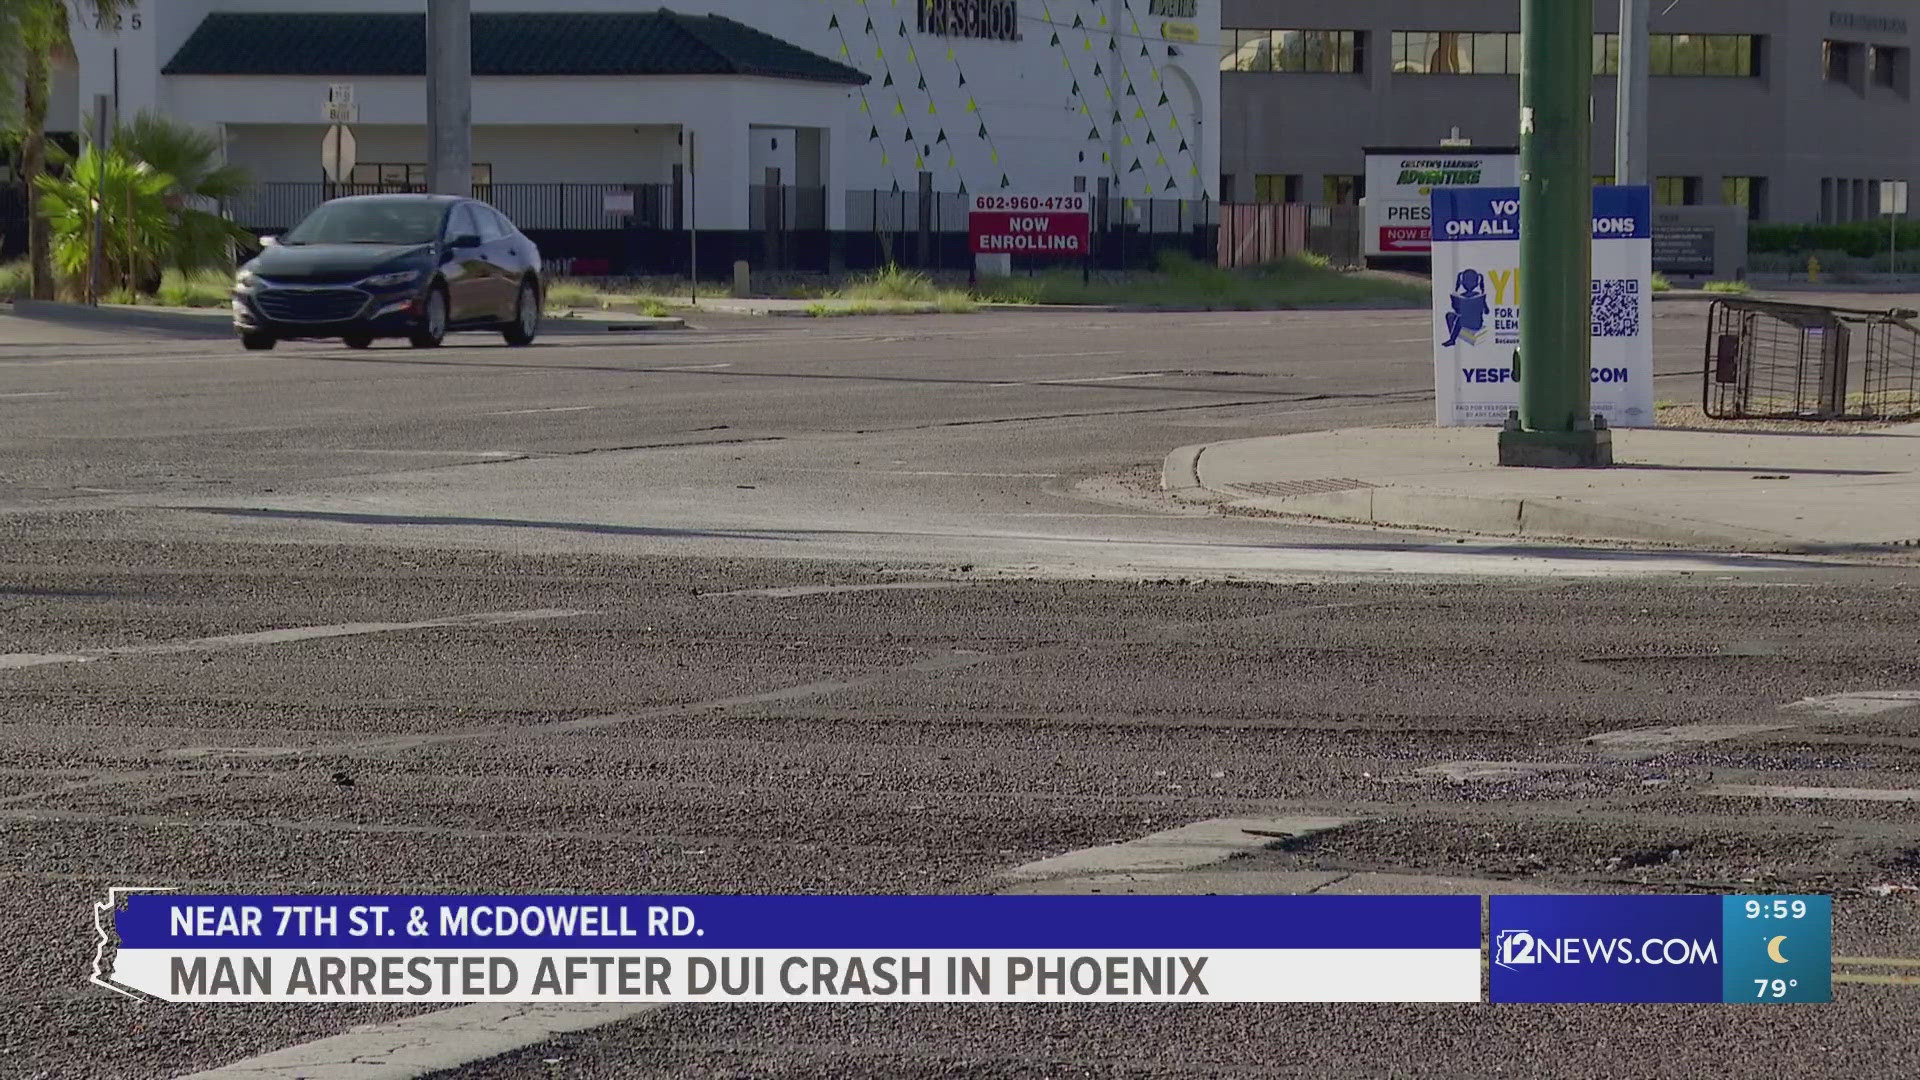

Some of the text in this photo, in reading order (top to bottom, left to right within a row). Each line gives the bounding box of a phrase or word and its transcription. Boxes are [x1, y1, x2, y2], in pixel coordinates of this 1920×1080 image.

[1388, 206, 1431, 220] PRES
[1009, 217, 1049, 232] NOW
[1445, 220, 1474, 235] ON
[1478, 220, 1514, 235] ALL
[1387, 229, 1417, 239] NOW
[980, 235, 1078, 249] ENROLLING
[1494, 308, 1513, 318] FOR
[1495, 320, 1519, 330] ELEM
